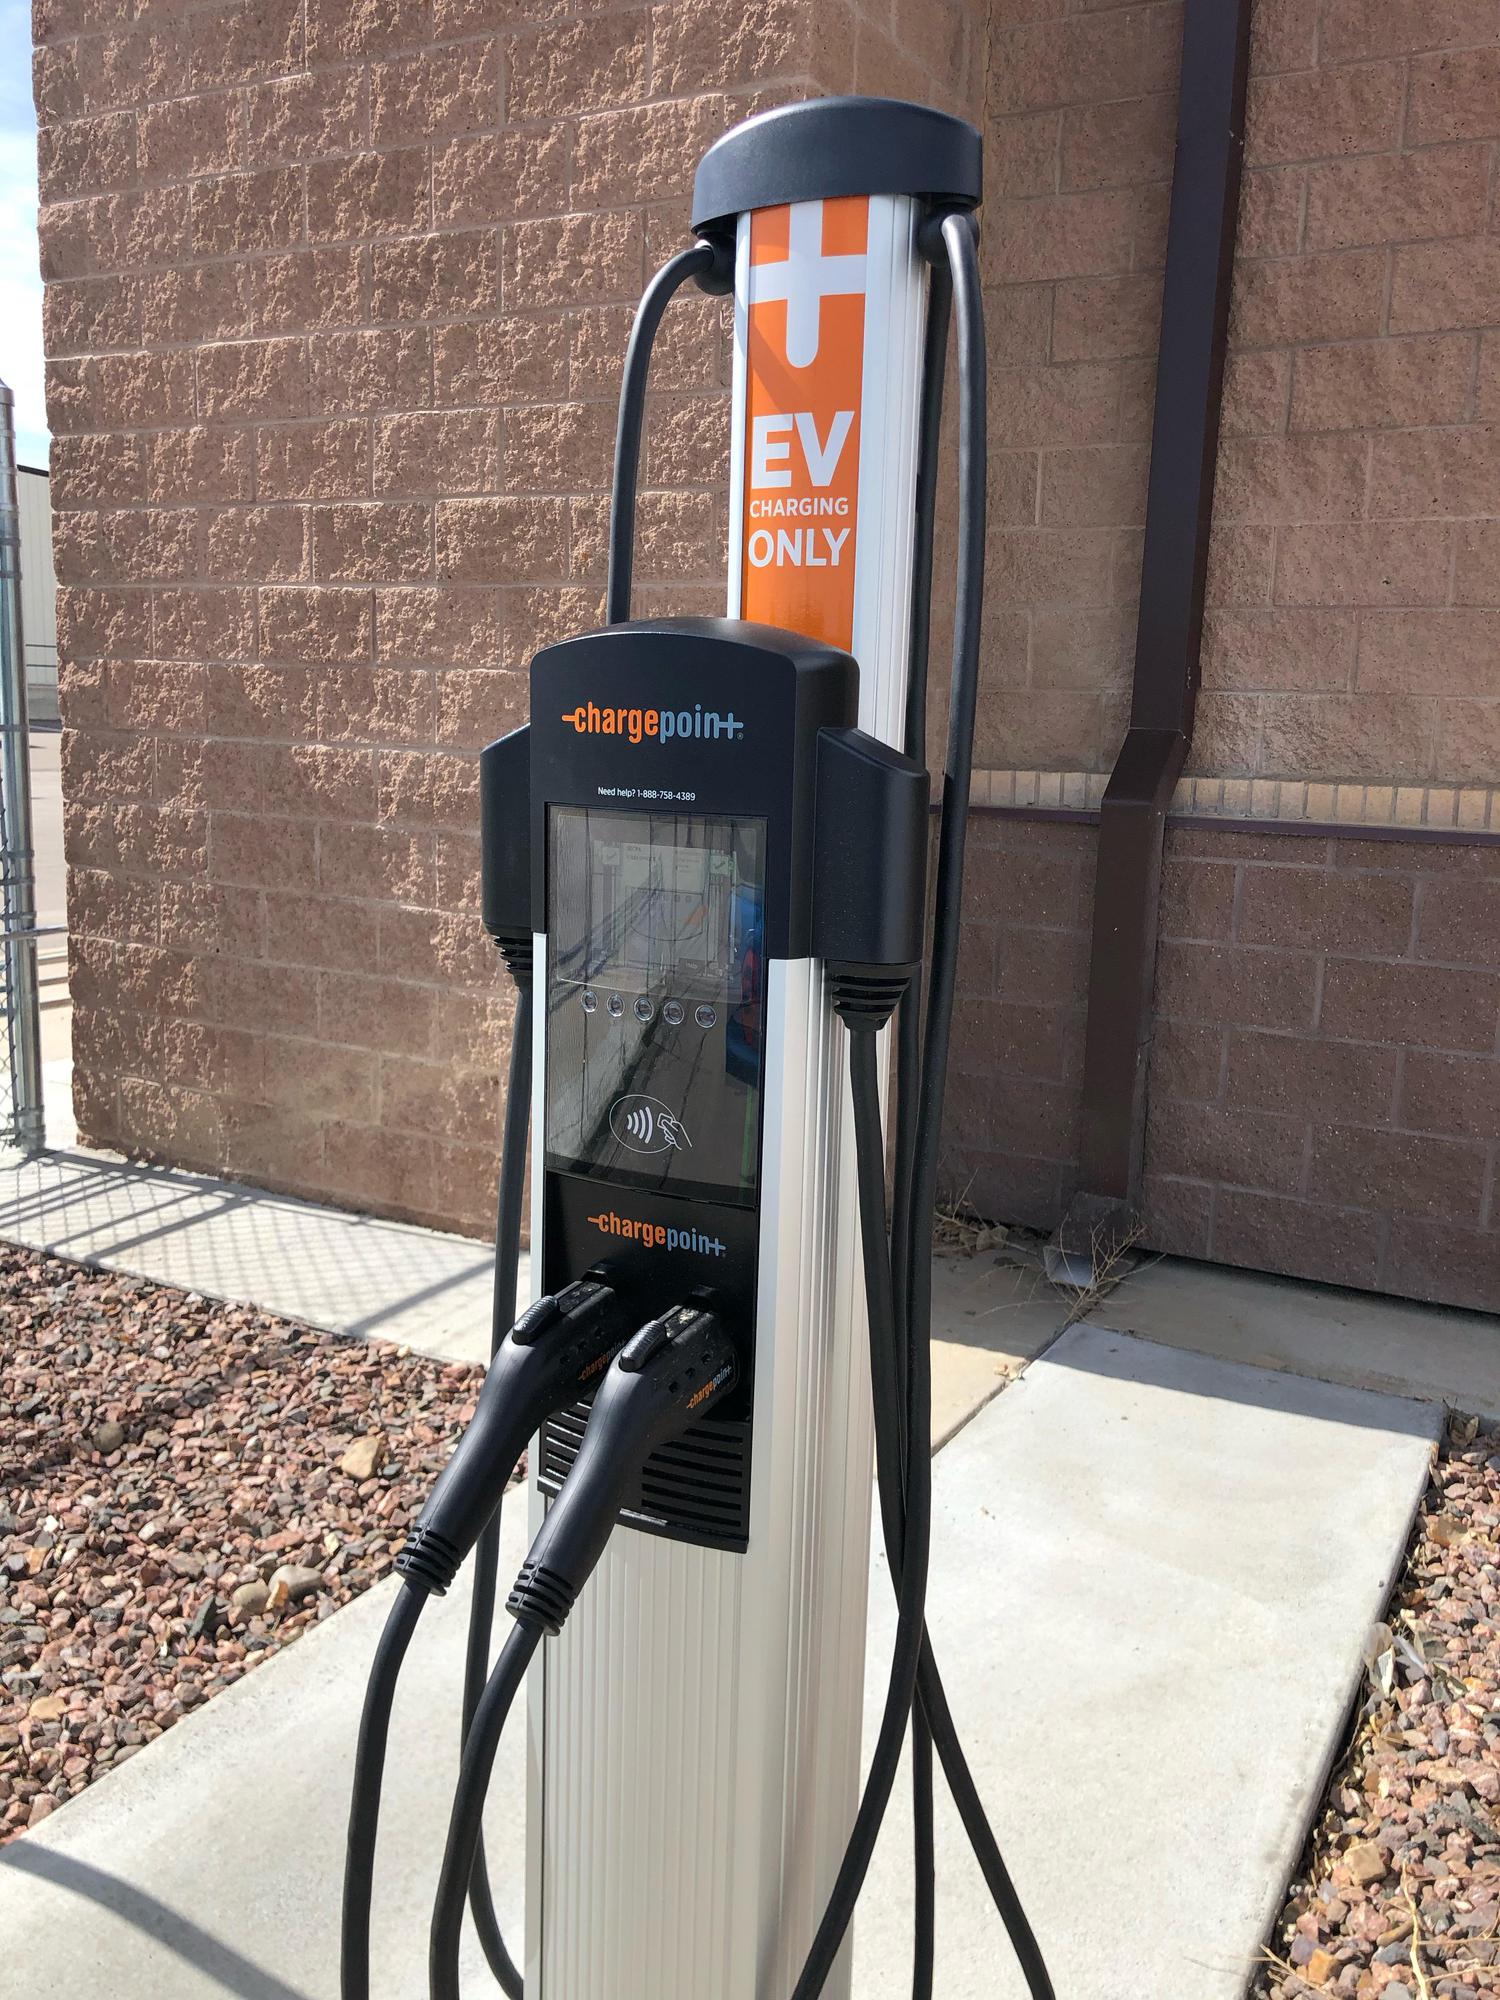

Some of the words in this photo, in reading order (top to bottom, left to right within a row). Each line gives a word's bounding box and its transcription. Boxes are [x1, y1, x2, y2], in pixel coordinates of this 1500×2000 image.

[752, 411, 855, 489] EV
[750, 497, 849, 518] CHARGING
[749, 528, 851, 568] ONLY
[598, 787, 616, 796] Need
[617, 788, 636, 798] help?
[637, 789, 696, 801] 1-888-758-4389
